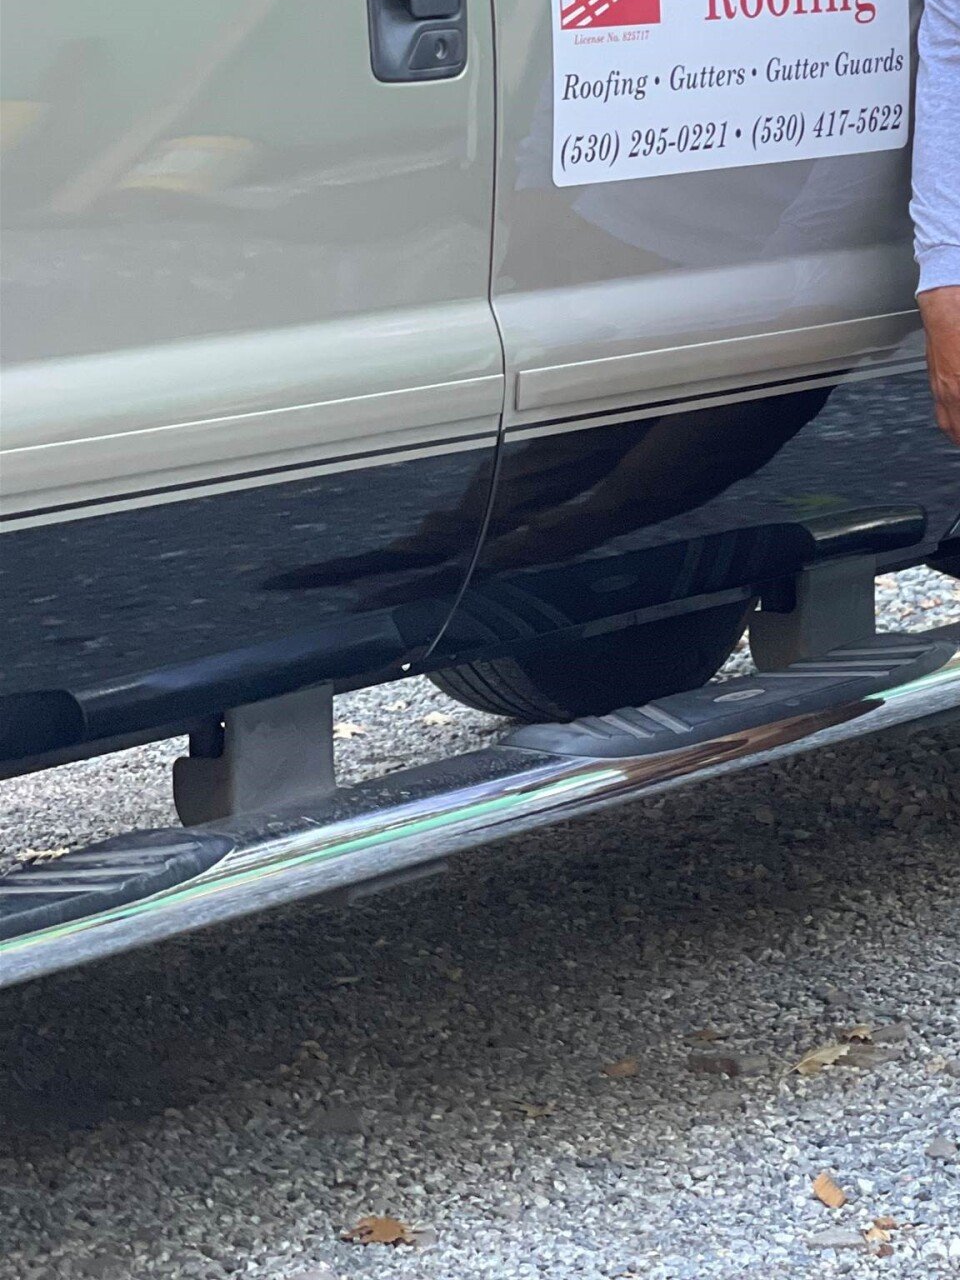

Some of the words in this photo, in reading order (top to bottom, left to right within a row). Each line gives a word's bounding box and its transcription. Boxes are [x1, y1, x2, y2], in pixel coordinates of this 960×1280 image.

[574, 34, 605, 46] License
[562, 70, 648, 103] Roofing
[669, 64, 746, 91] Gutters
[766, 57, 829, 83] Gutter
[835, 47, 904, 77] Guards
[561, 130, 620, 172] (530)
[628, 120, 728, 158] 295-0221
[752, 112, 805, 151] (530)
[813, 103, 903, 139] 417-5622
